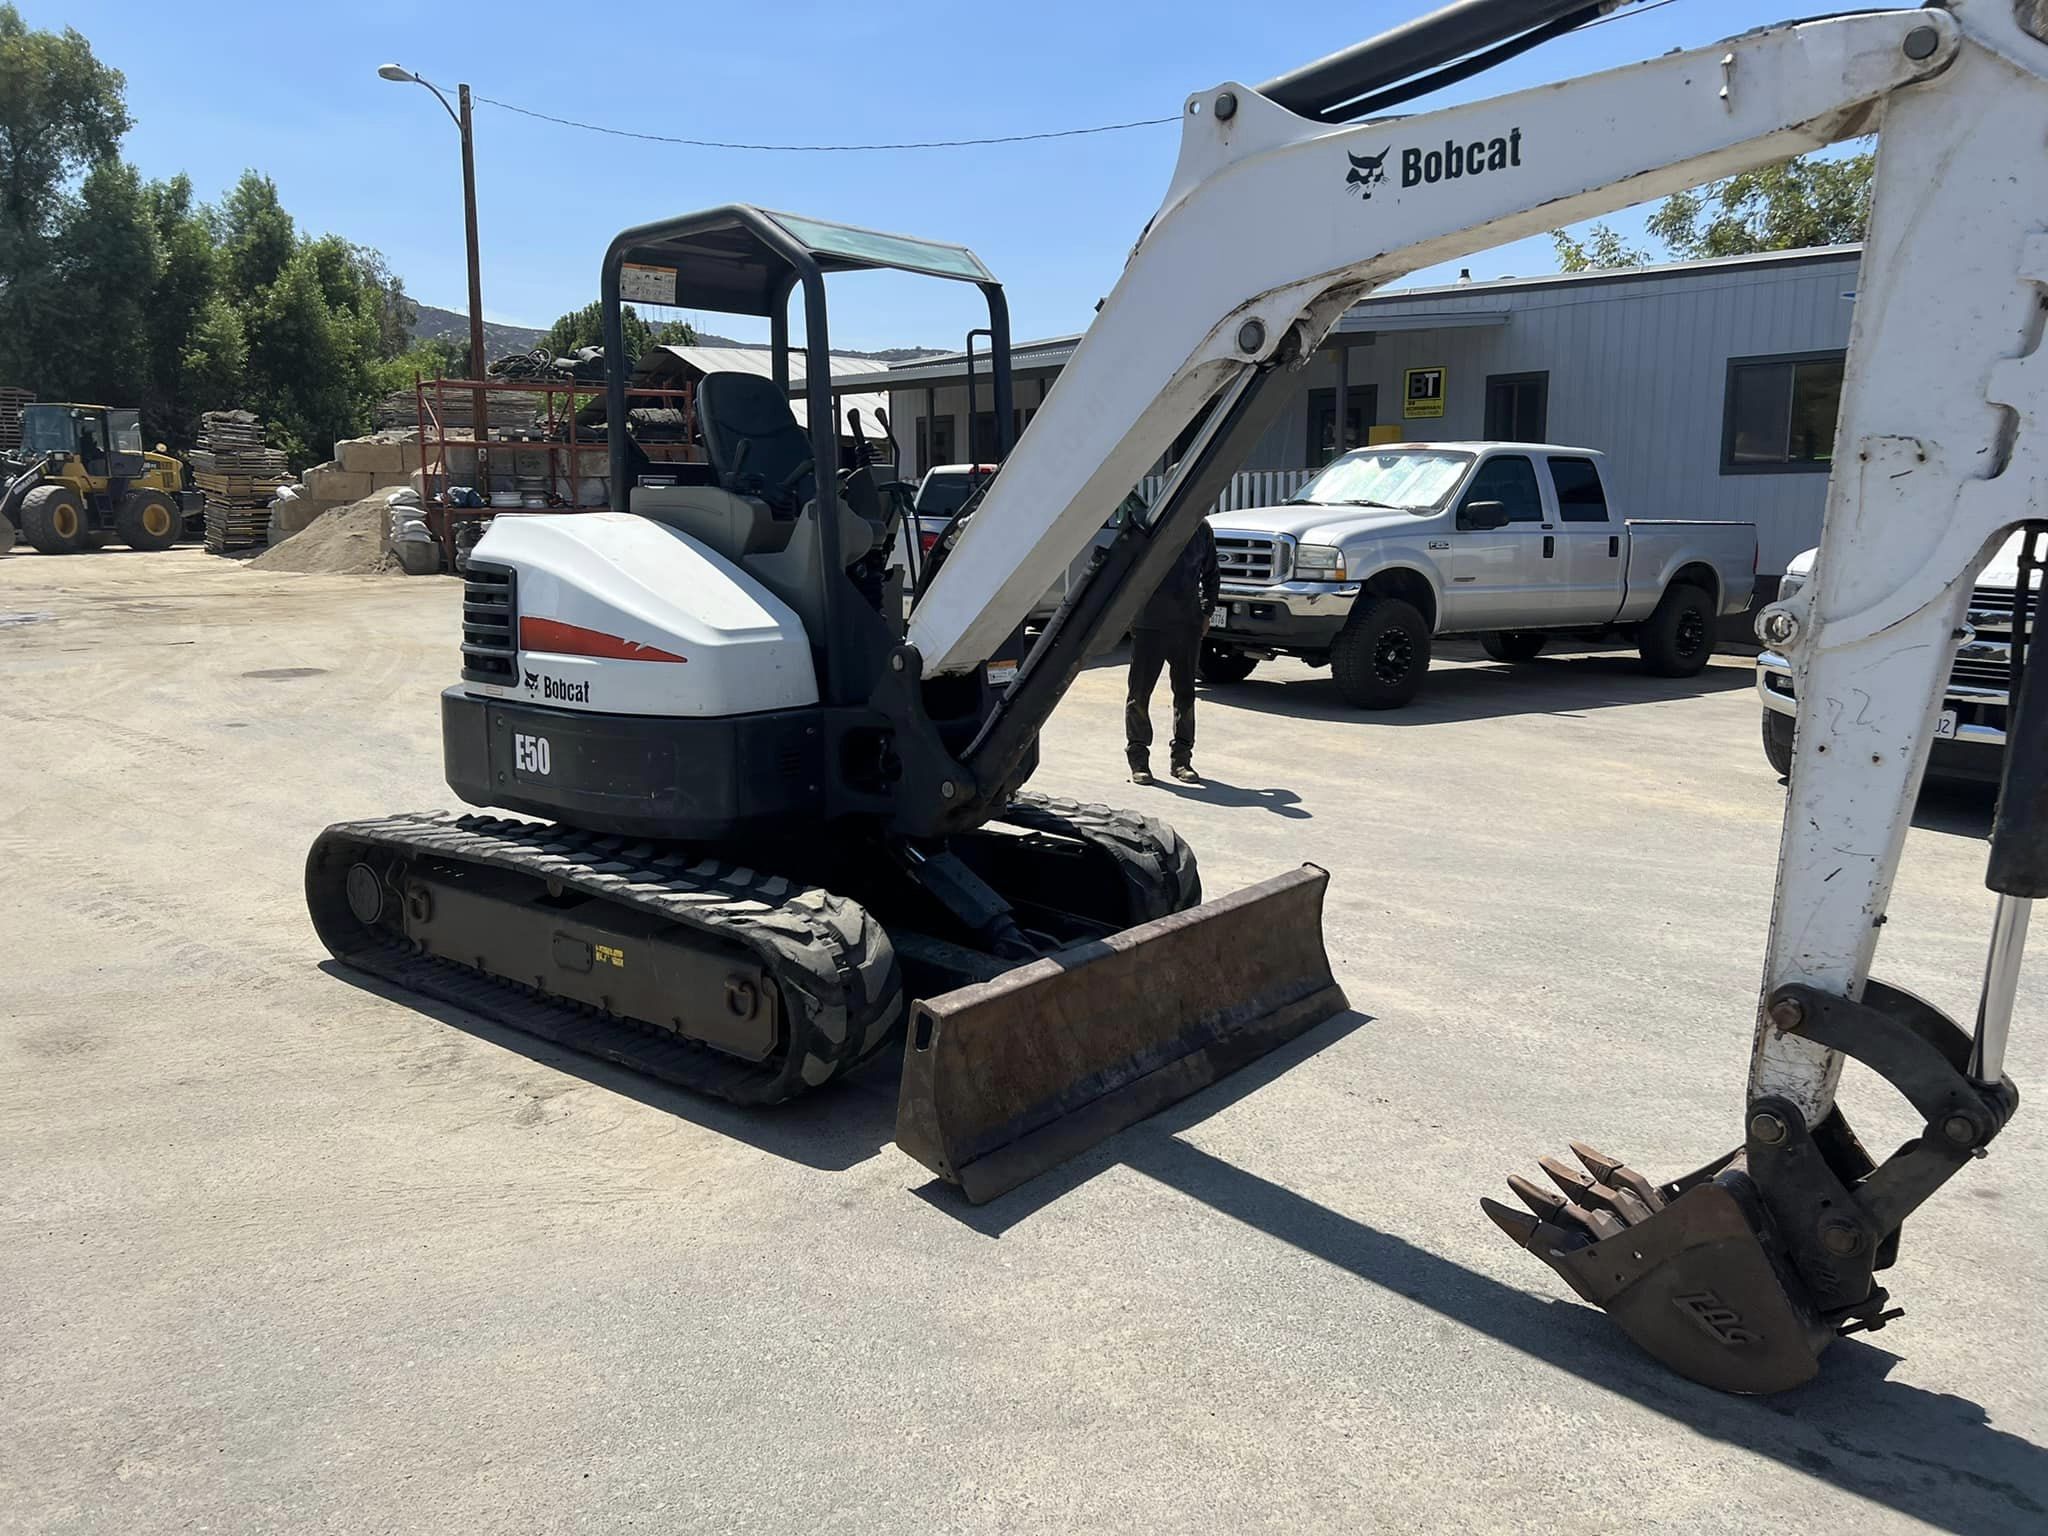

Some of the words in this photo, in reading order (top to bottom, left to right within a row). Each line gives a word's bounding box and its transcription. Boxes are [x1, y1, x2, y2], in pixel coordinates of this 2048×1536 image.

[1401, 127, 1522, 188] Bobcat
[1410, 372, 1440, 398] BT
[544, 675, 590, 704] Bobcat
[514, 733, 551, 775] E50
